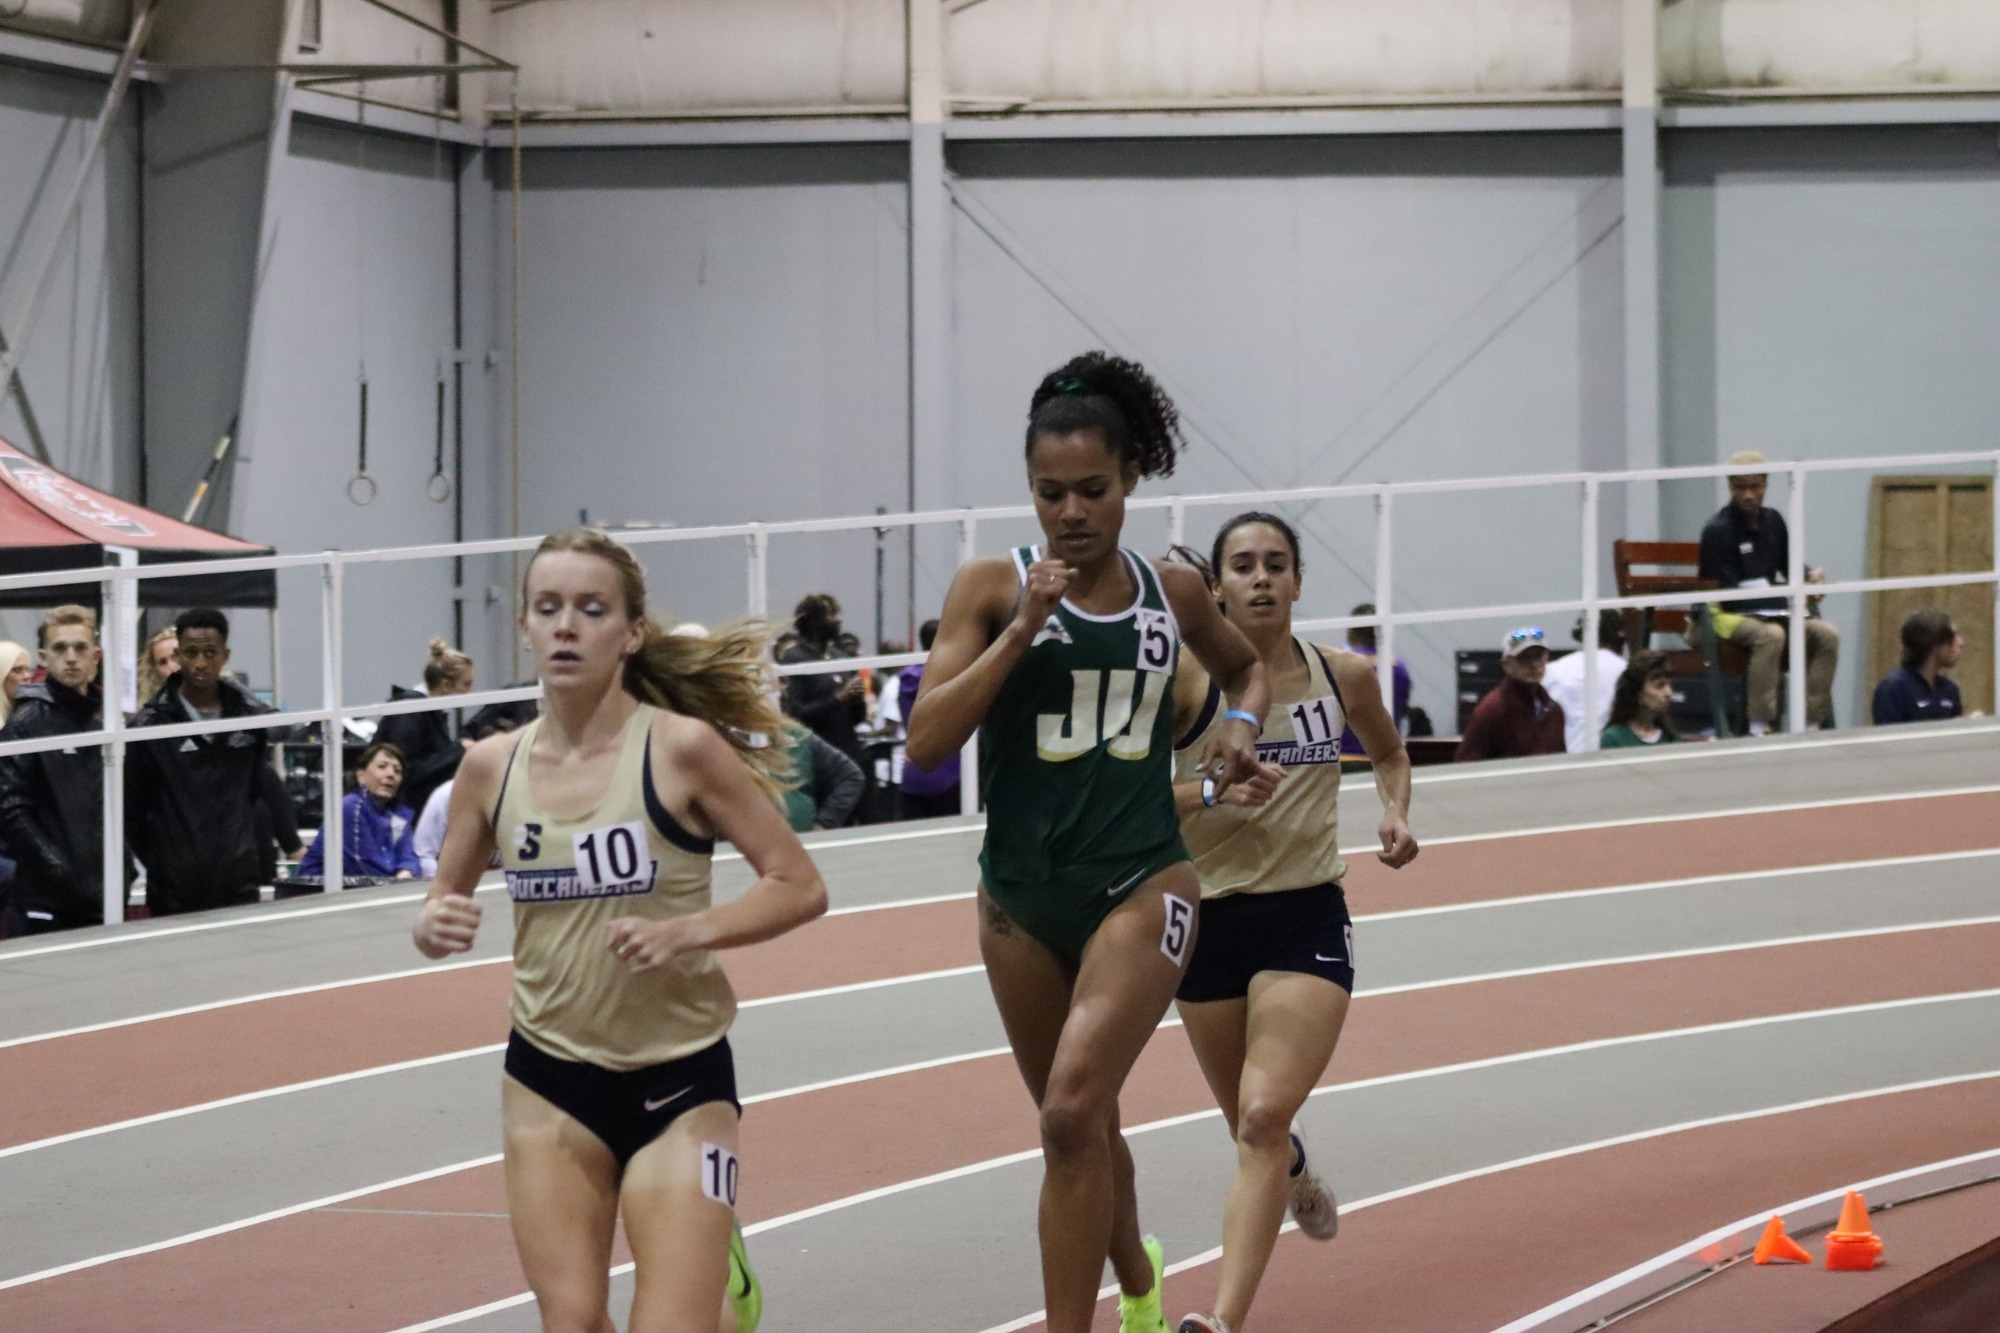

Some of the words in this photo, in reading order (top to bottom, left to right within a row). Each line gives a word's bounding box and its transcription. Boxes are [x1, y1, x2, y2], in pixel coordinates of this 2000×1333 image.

[1144, 616, 1170, 668] 5
[1037, 670, 1168, 762] JU
[1293, 700, 1331, 743] 11
[1256, 741, 1340, 765] CCANEERS
[579, 828, 638, 884] 10
[1166, 900, 1188, 957] 5
[707, 1149, 738, 1207] 10
